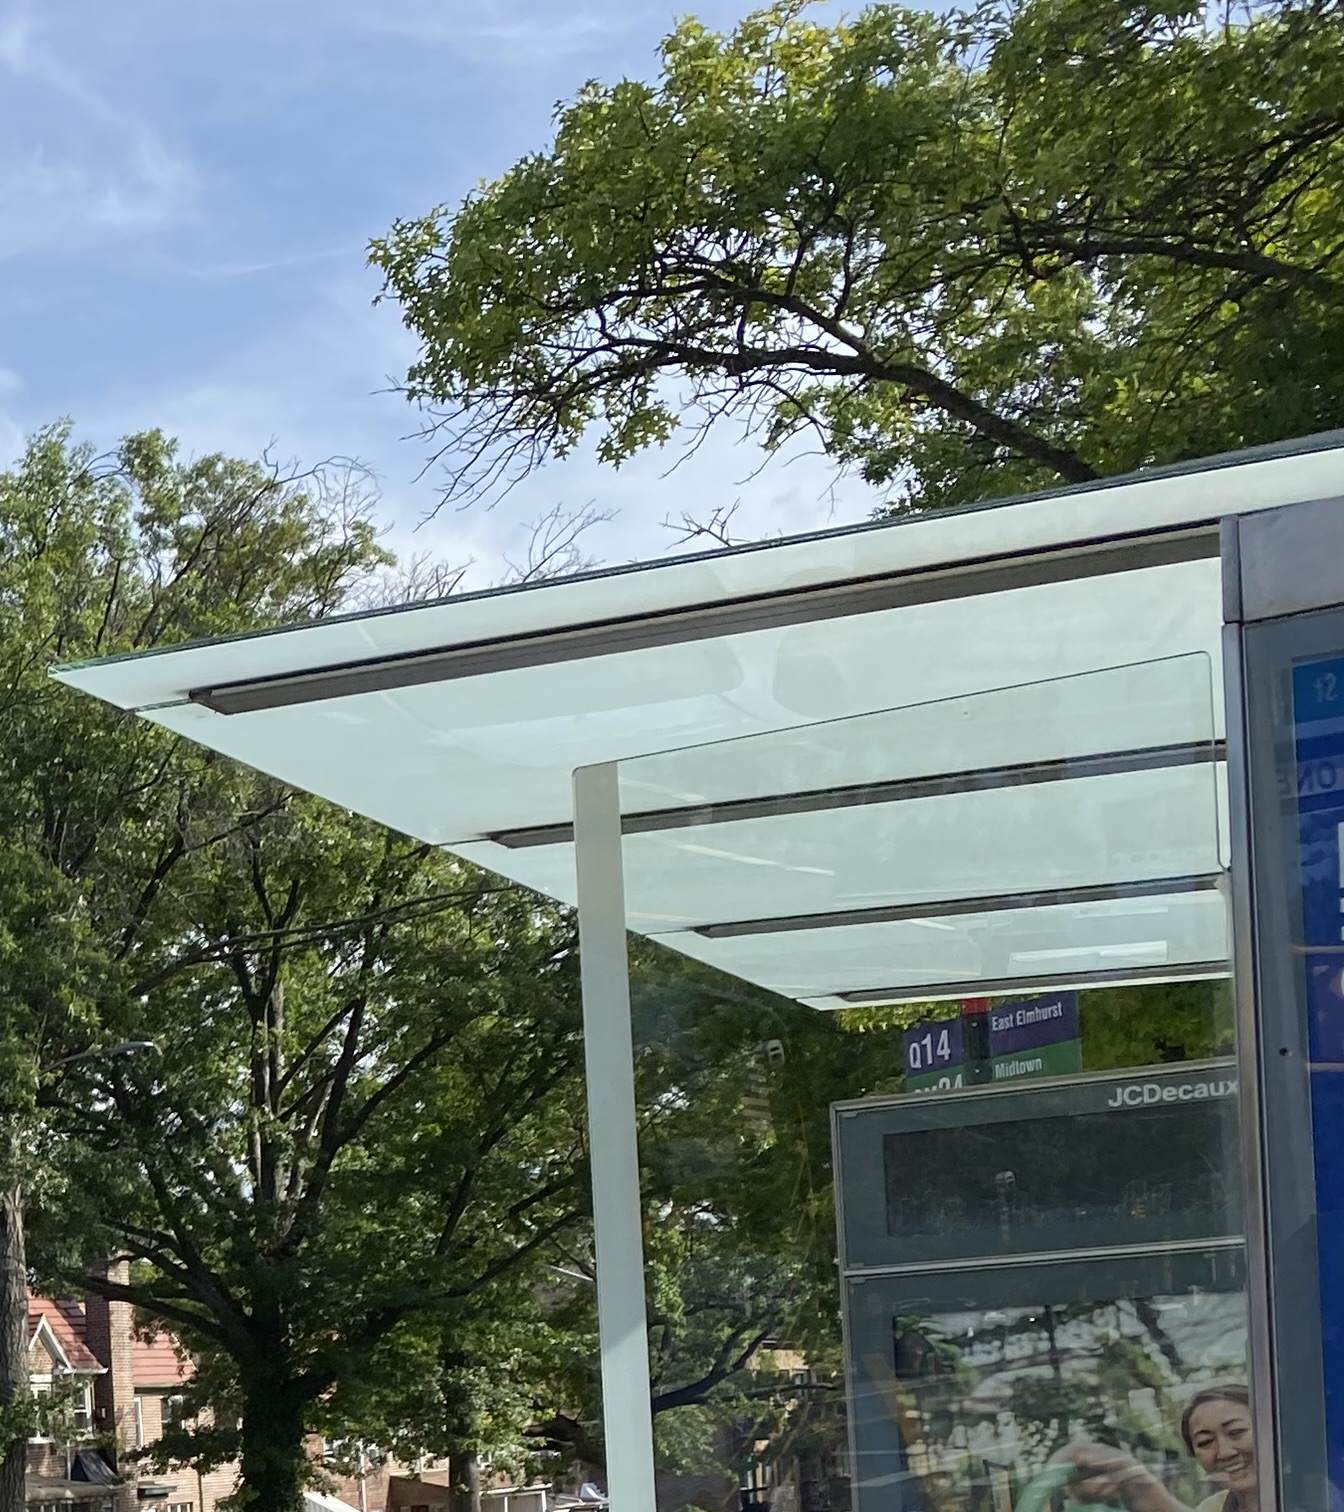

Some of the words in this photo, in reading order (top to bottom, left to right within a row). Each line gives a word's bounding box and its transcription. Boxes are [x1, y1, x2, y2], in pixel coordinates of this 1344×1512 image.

[992, 1014, 1014, 1031] East
[1016, 1001, 1063, 1025] Elmhurst
[908, 1029, 951, 1069] Q14
[995, 1057, 1043, 1079] Midtown
[1108, 1080, 1238, 1107] JCDecaux
